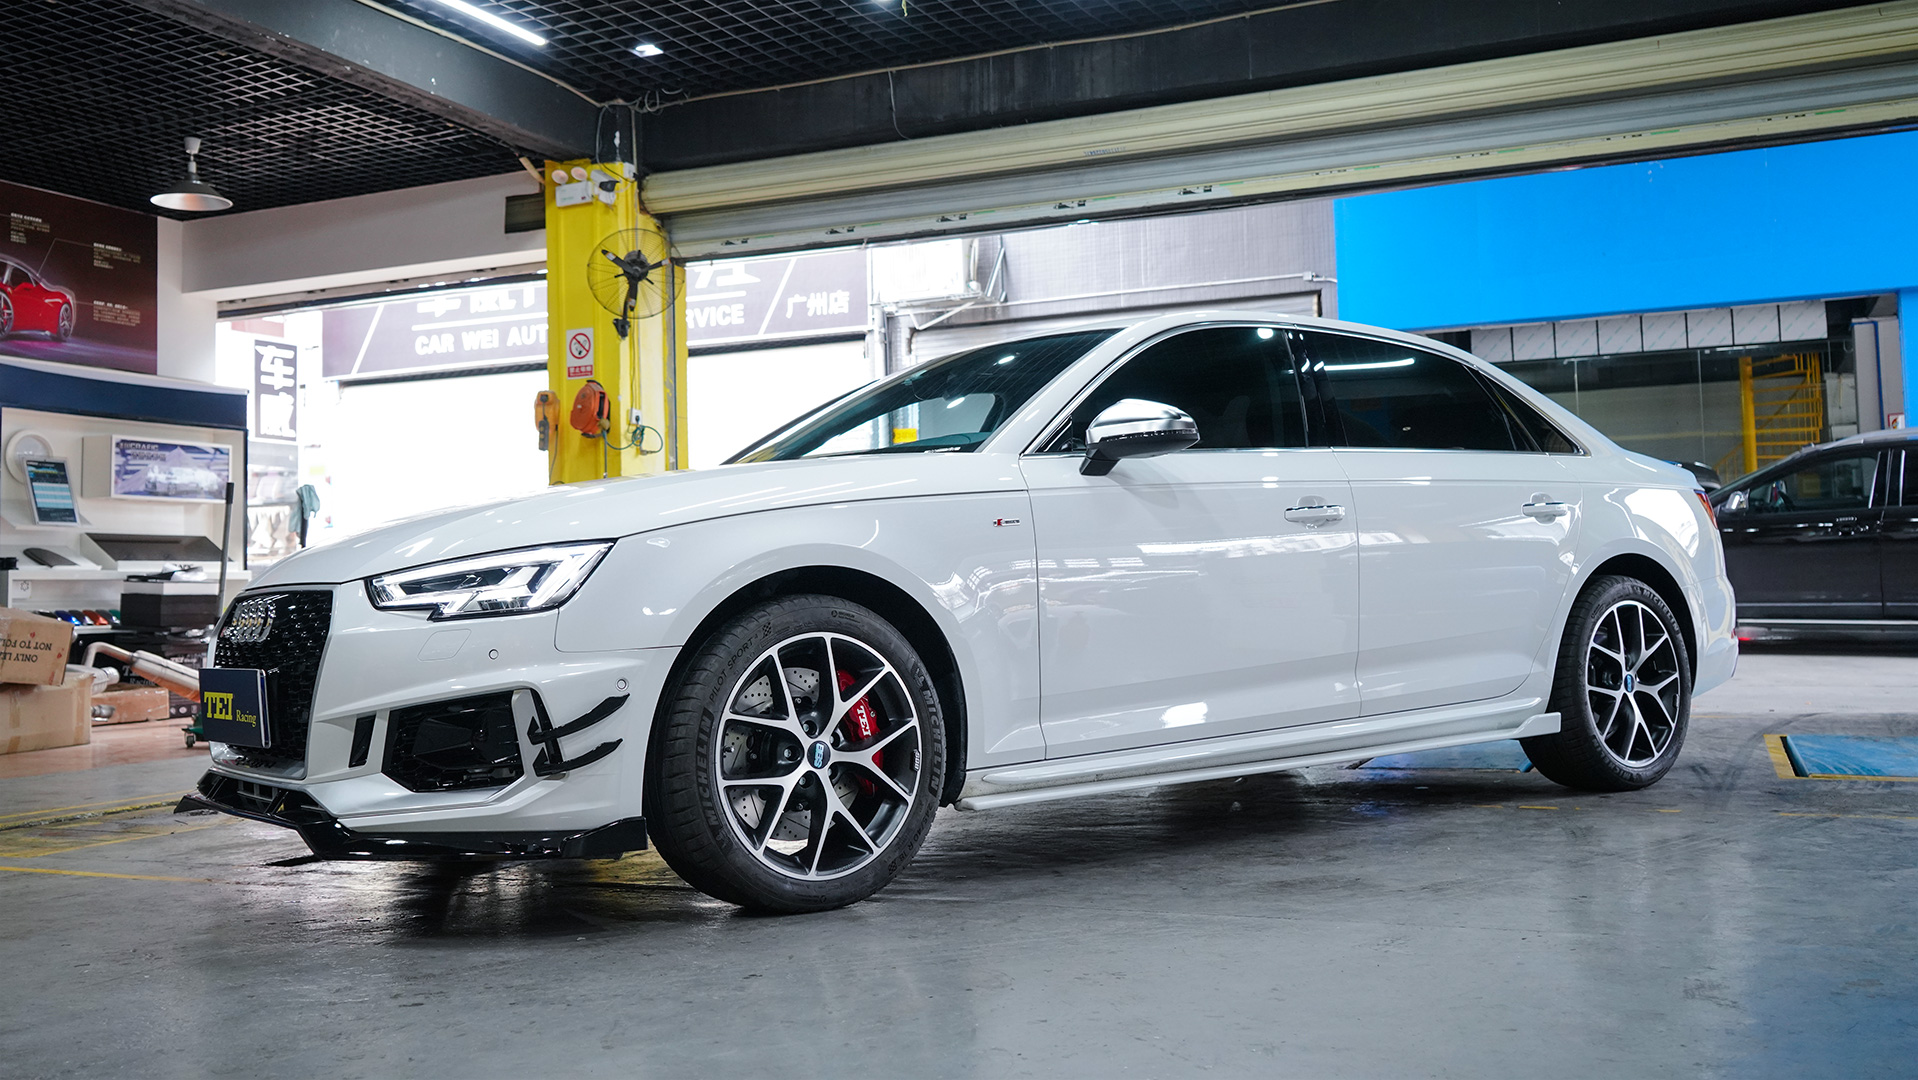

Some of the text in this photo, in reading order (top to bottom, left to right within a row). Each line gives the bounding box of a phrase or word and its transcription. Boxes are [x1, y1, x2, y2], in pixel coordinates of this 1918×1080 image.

[785, 289, 850, 319] 广州店
[414, 332, 455, 355] CAR
[462, 328, 500, 351] WEI
[1643, 589, 1680, 632] MICHELIN
[13, 653, 38, 663] ONLY
[19, 640, 31, 649] TO
[33, 642, 52, 651] NOT
[709, 669, 728, 702] PILOT
[727, 638, 754, 670] SPORT
[203, 691, 257, 728] TEI Racing
[857, 705, 871, 737] TEI
[814, 743, 825, 768] BBS
[923, 690, 942, 791] MICHELIN
[697, 714, 719, 827] MICHELIN
